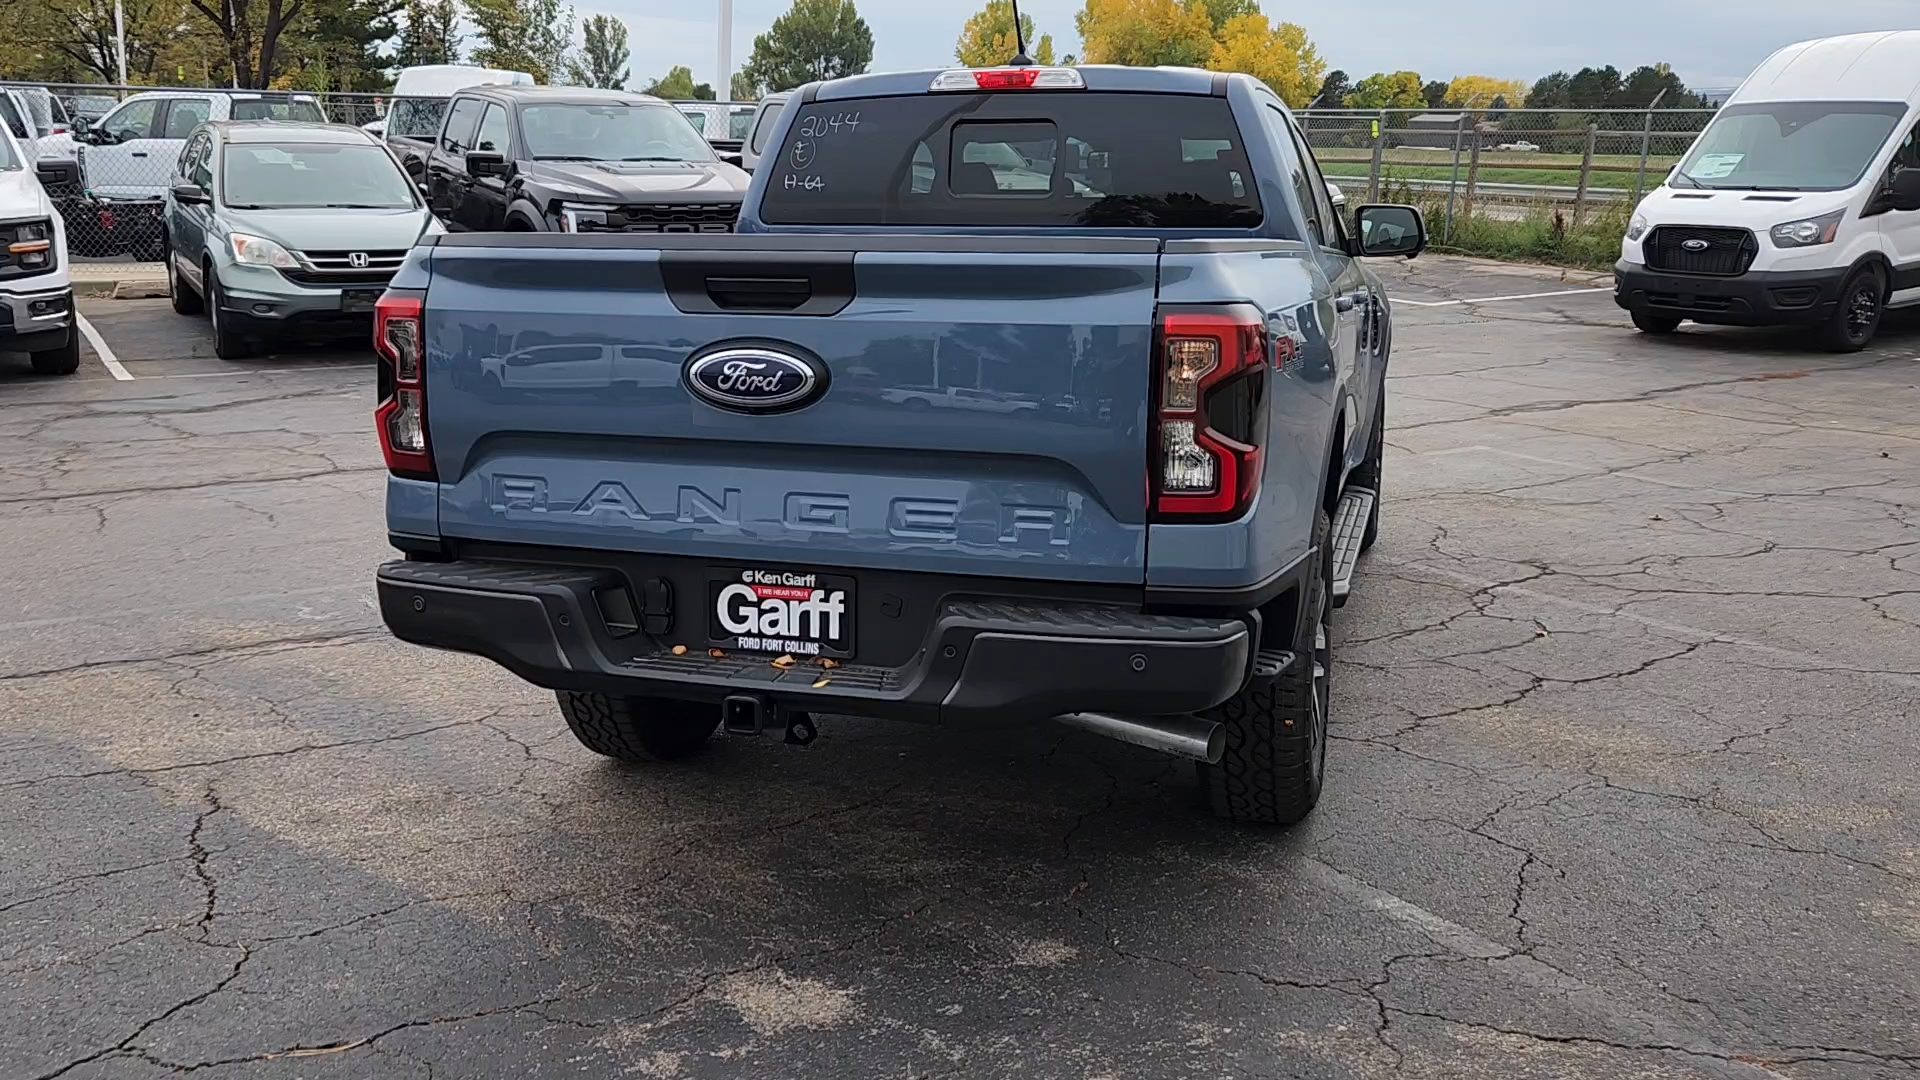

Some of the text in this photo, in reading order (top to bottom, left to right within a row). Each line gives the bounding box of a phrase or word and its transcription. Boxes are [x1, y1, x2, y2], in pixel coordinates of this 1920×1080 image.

[801, 111, 860, 137] 2044
[717, 360, 785, 393] Ford
[490, 472, 1071, 547] RANGER
[754, 570, 782, 585] Ken
[782, 572, 816, 588] Garff
[763, 588, 804, 598] WE HEAR YOU
[716, 583, 845, 640] Garff
[738, 636, 820, 655] FORD FORT COLLINS
